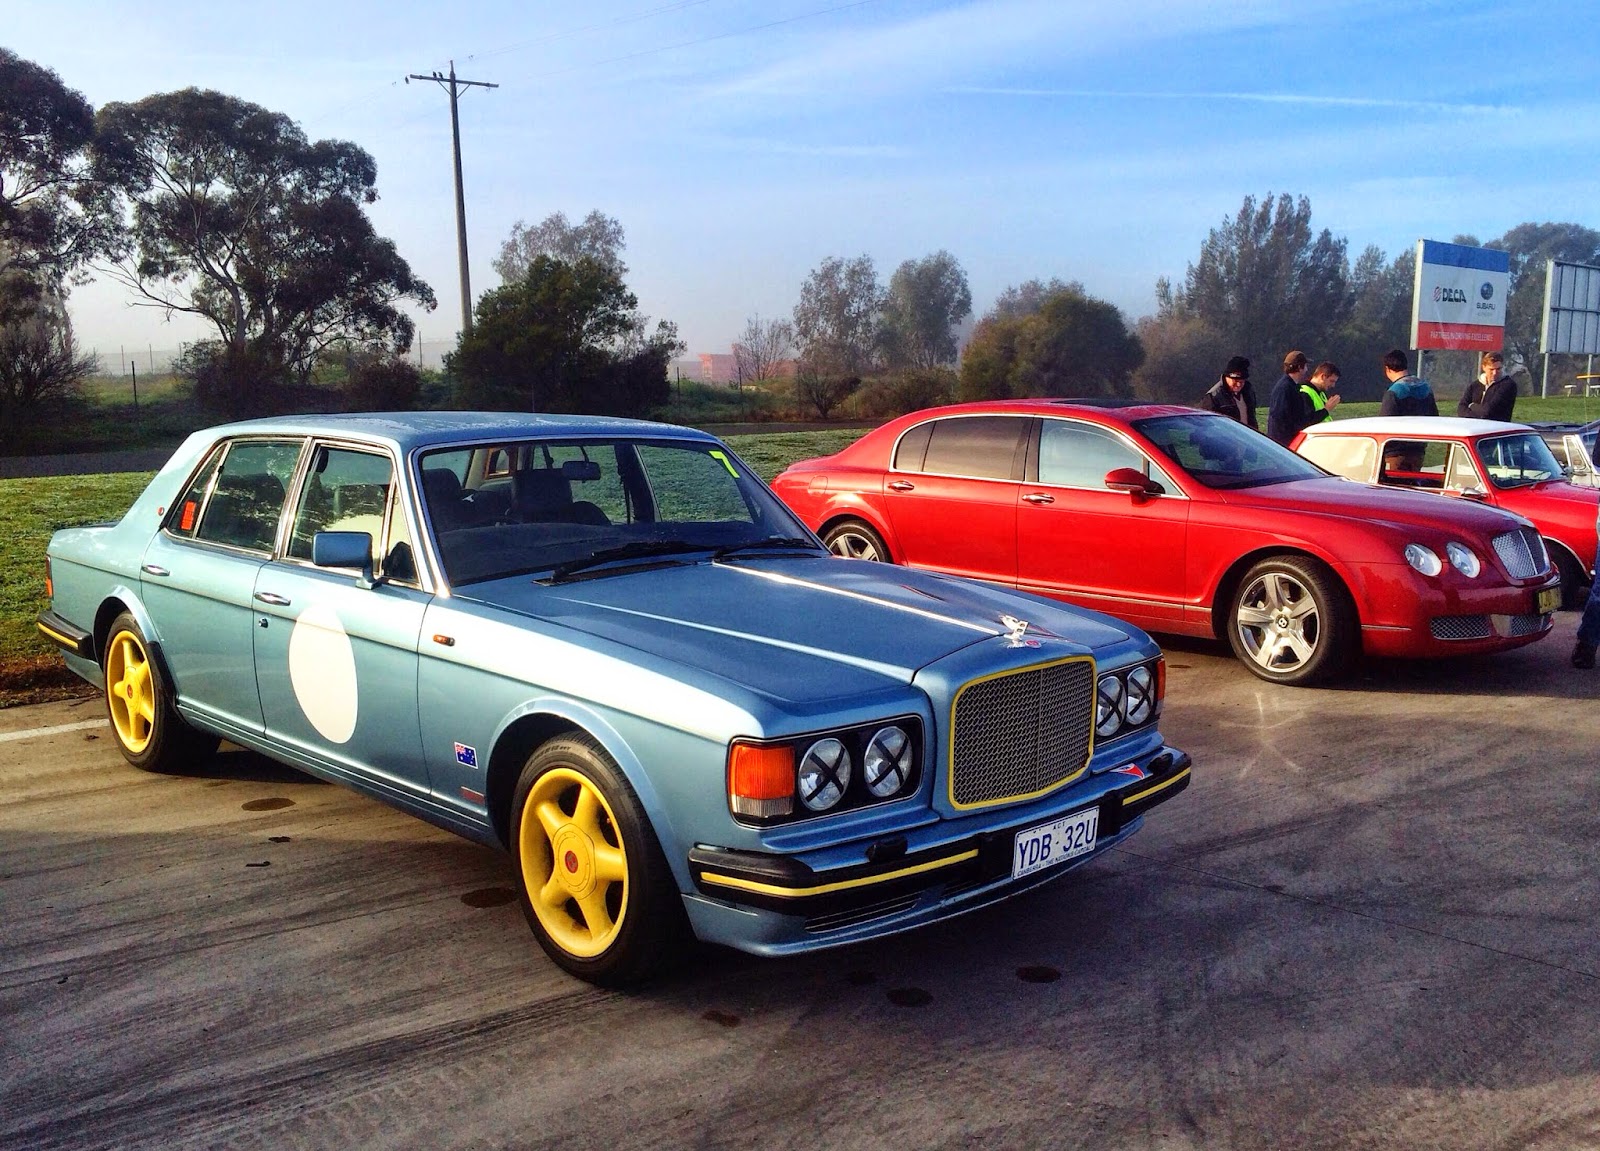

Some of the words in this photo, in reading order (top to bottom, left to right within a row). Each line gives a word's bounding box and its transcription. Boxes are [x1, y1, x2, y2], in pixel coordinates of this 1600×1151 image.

[1442, 288, 1467, 303] DECA
[1053, 820, 1066, 830] ACT
[1018, 833, 1052, 869] YDB
[1062, 817, 1097, 852] 32U
